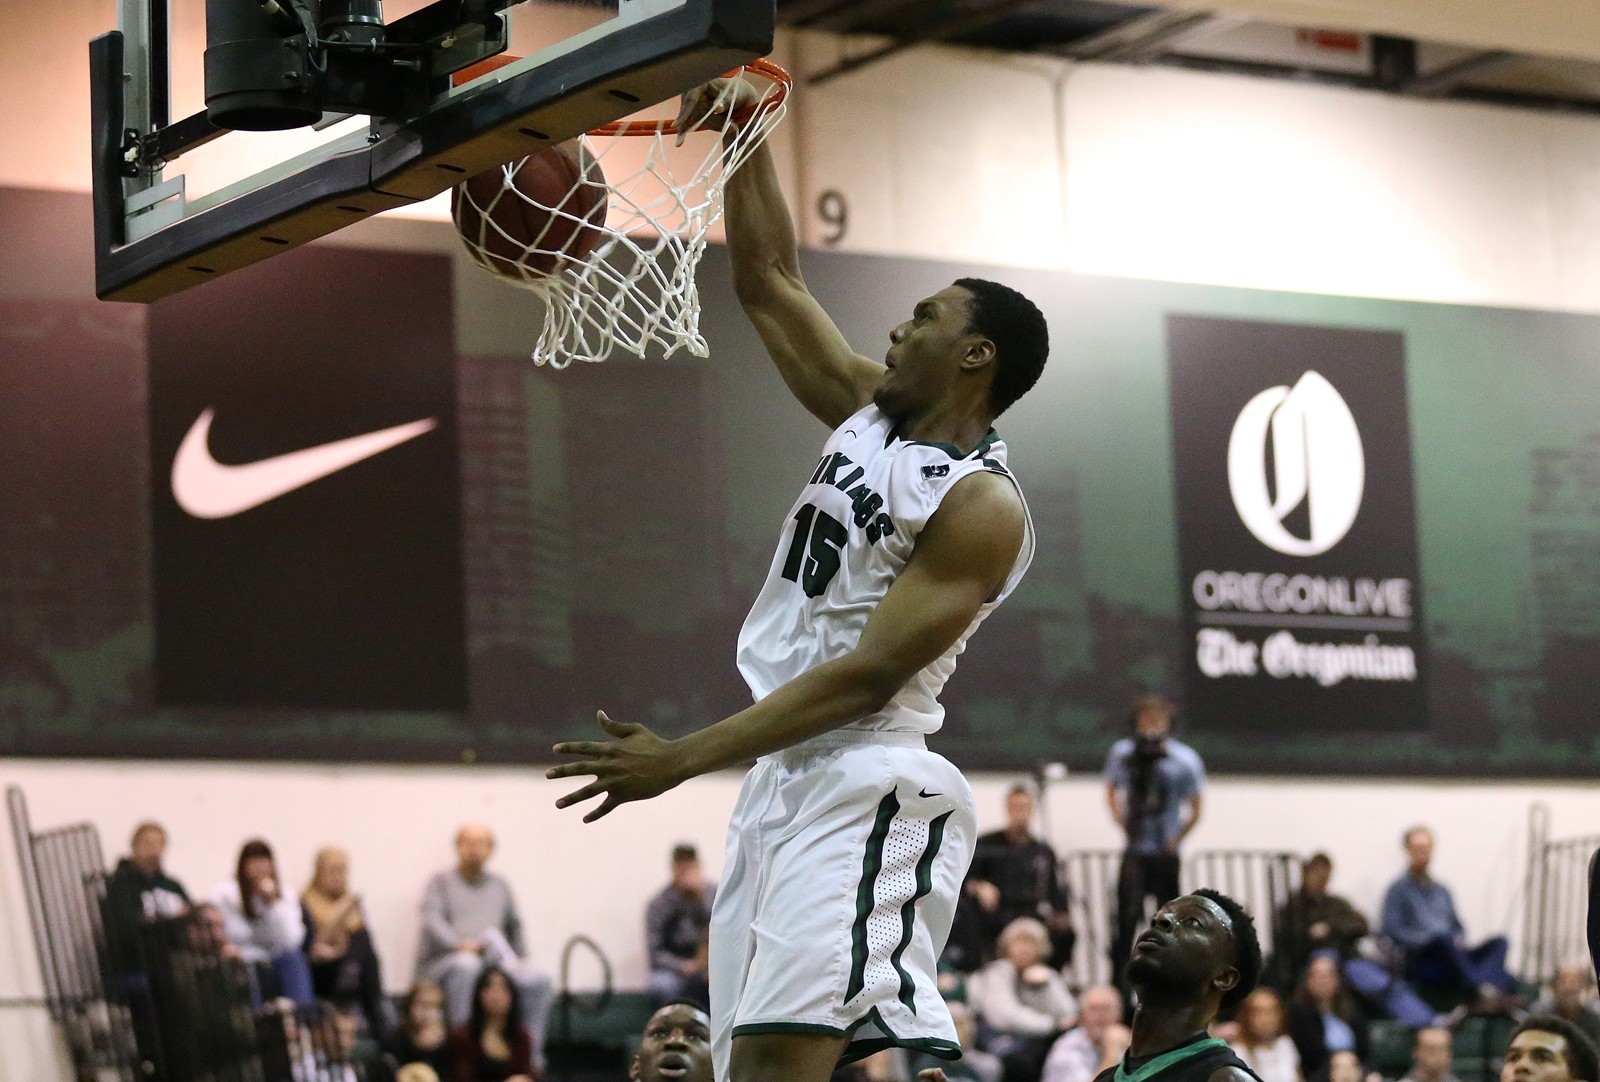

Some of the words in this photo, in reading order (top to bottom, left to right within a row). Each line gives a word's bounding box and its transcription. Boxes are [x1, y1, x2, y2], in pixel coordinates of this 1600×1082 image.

[817, 188, 847, 244] 9
[809, 452, 895, 547] IKINGS
[781, 503, 849, 599] 15
[1193, 570, 1411, 617] OREGONLIVE
[1197, 628, 1258, 677] The
